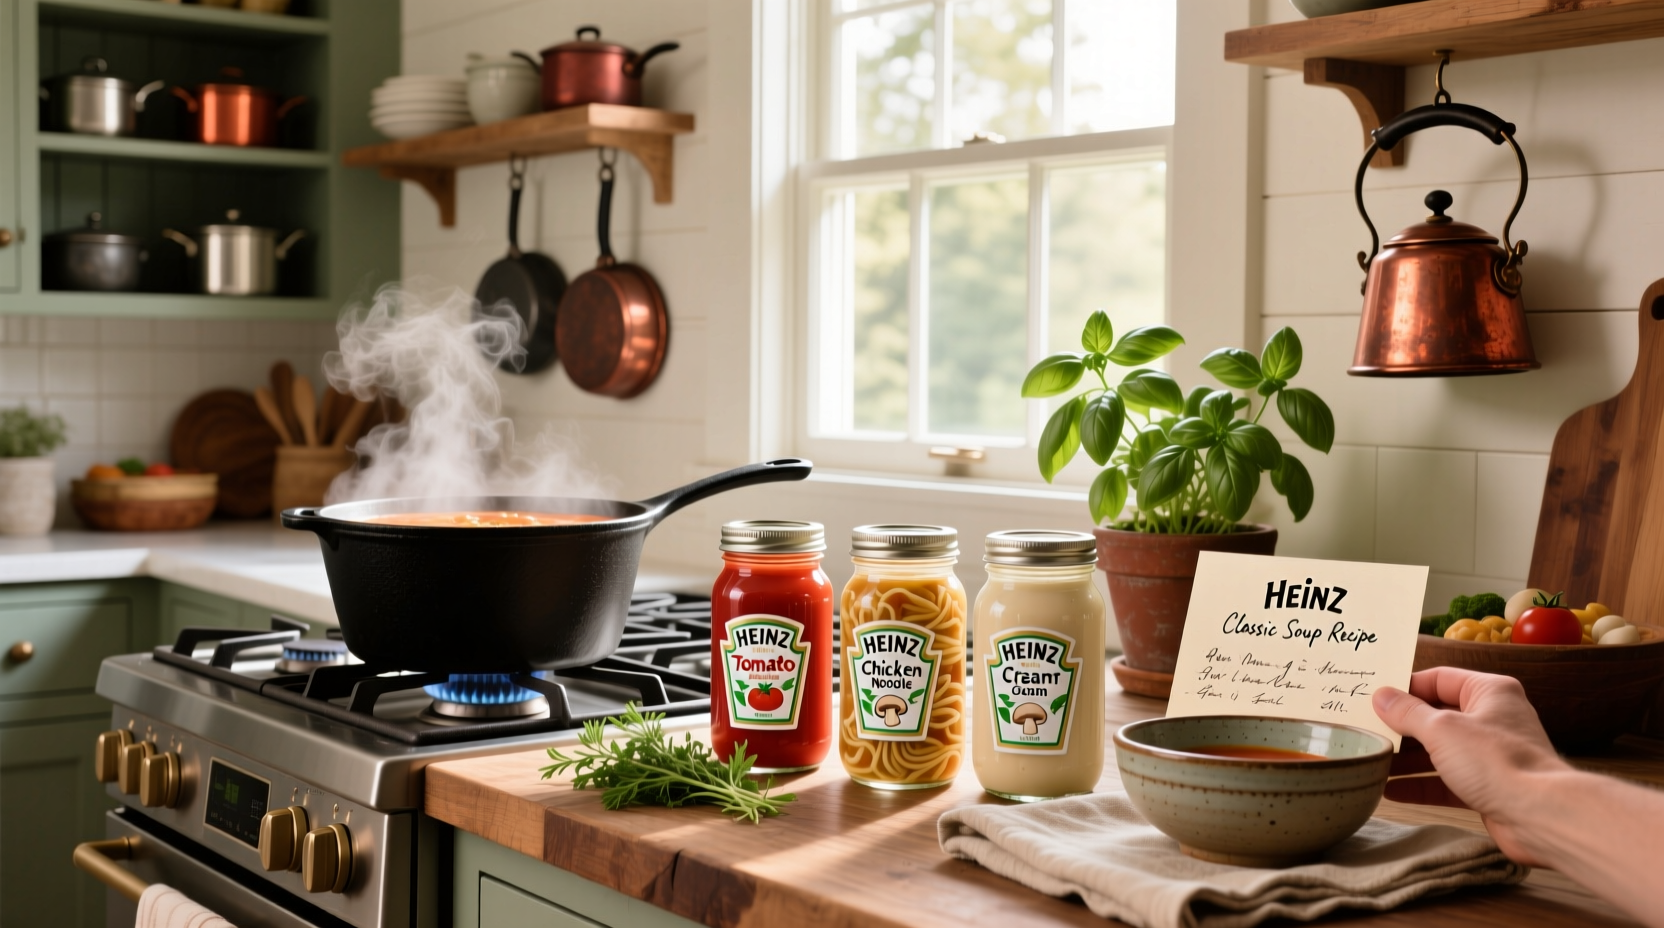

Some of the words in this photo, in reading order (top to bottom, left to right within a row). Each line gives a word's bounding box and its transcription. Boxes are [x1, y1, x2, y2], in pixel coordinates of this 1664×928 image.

[735, 628, 791, 649] HEINZ
[1222, 612, 1278, 637] Classic
[1282, 619, 1323, 648] Soup
[1327, 621, 1378, 651] Recipe
[863, 634, 920, 657] HEINZ
[1002, 641, 1059, 664] HEINZ
[731, 654, 796, 673] Tomato
[861, 659, 922, 677] Chicken
